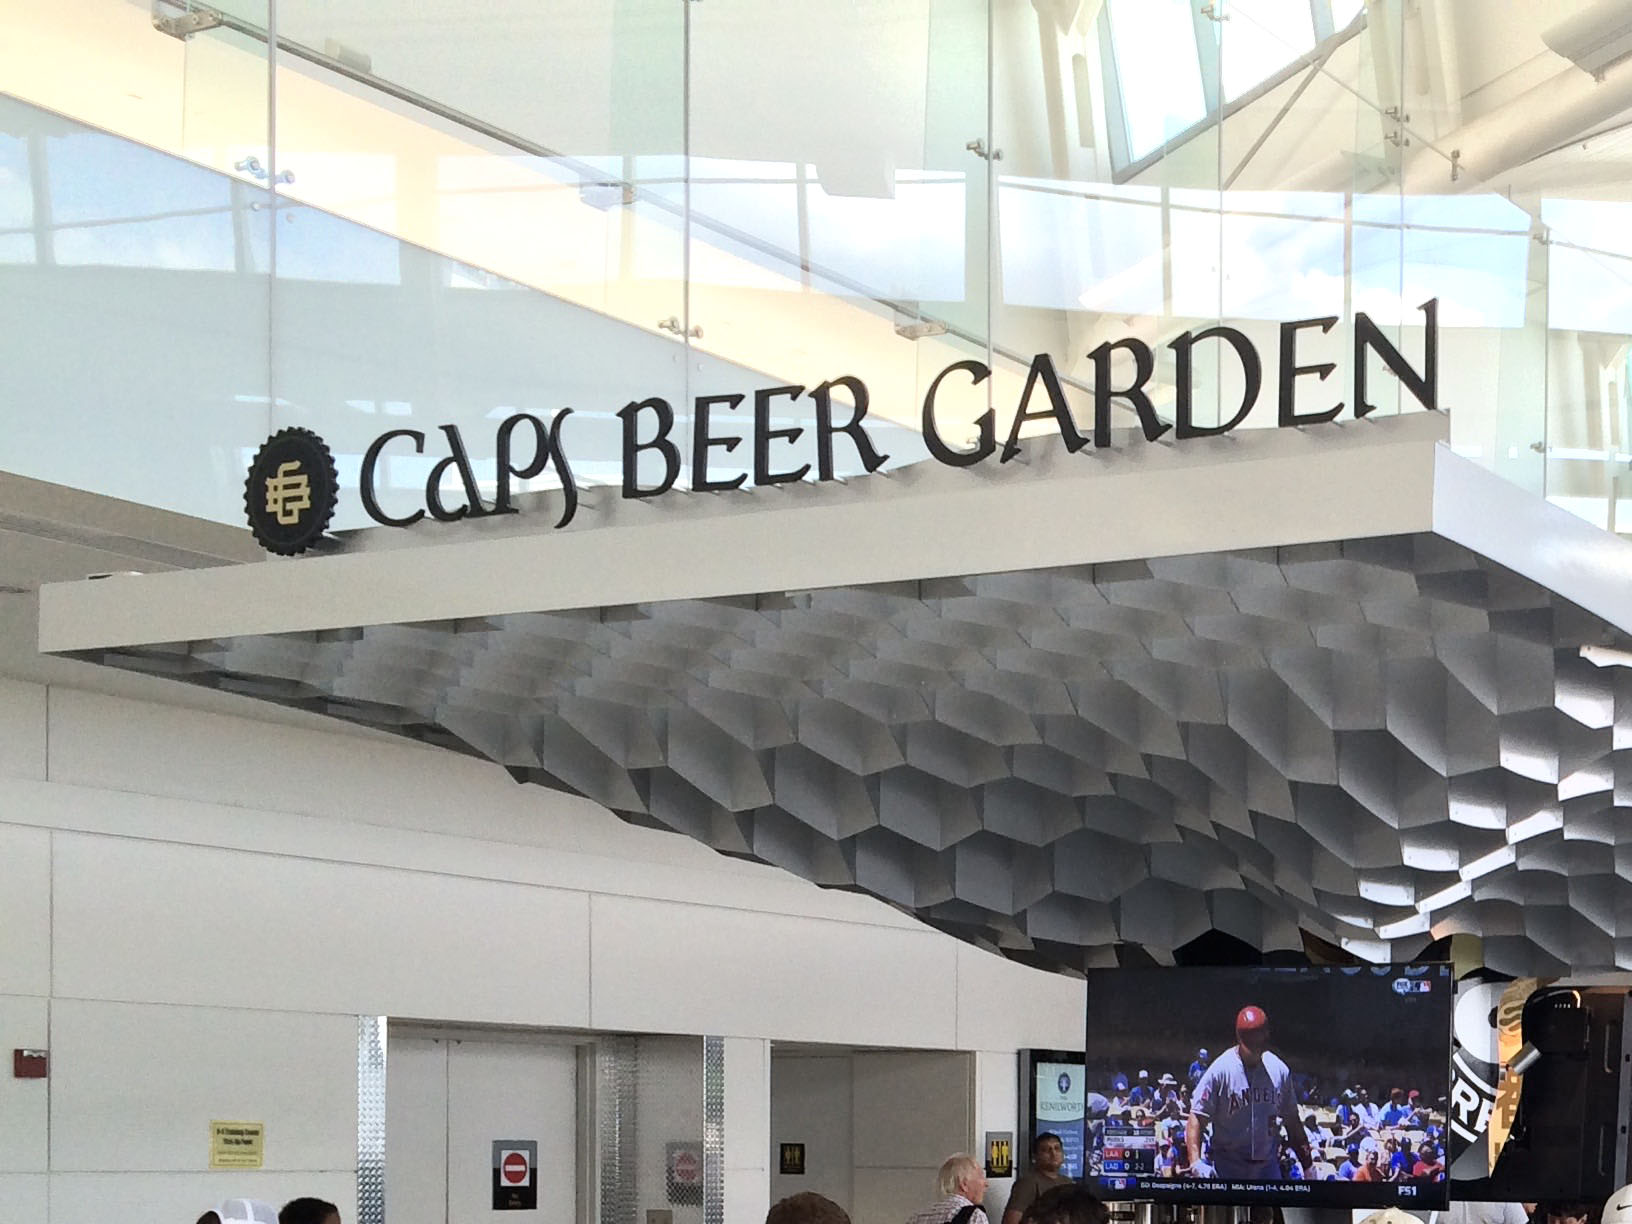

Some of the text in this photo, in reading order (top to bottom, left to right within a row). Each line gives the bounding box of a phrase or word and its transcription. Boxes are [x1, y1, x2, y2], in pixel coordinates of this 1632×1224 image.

[615, 374, 890, 499] BEER
[922, 296, 1440, 468] GARDEN
[1398, 1185, 1417, 1196] FS1
